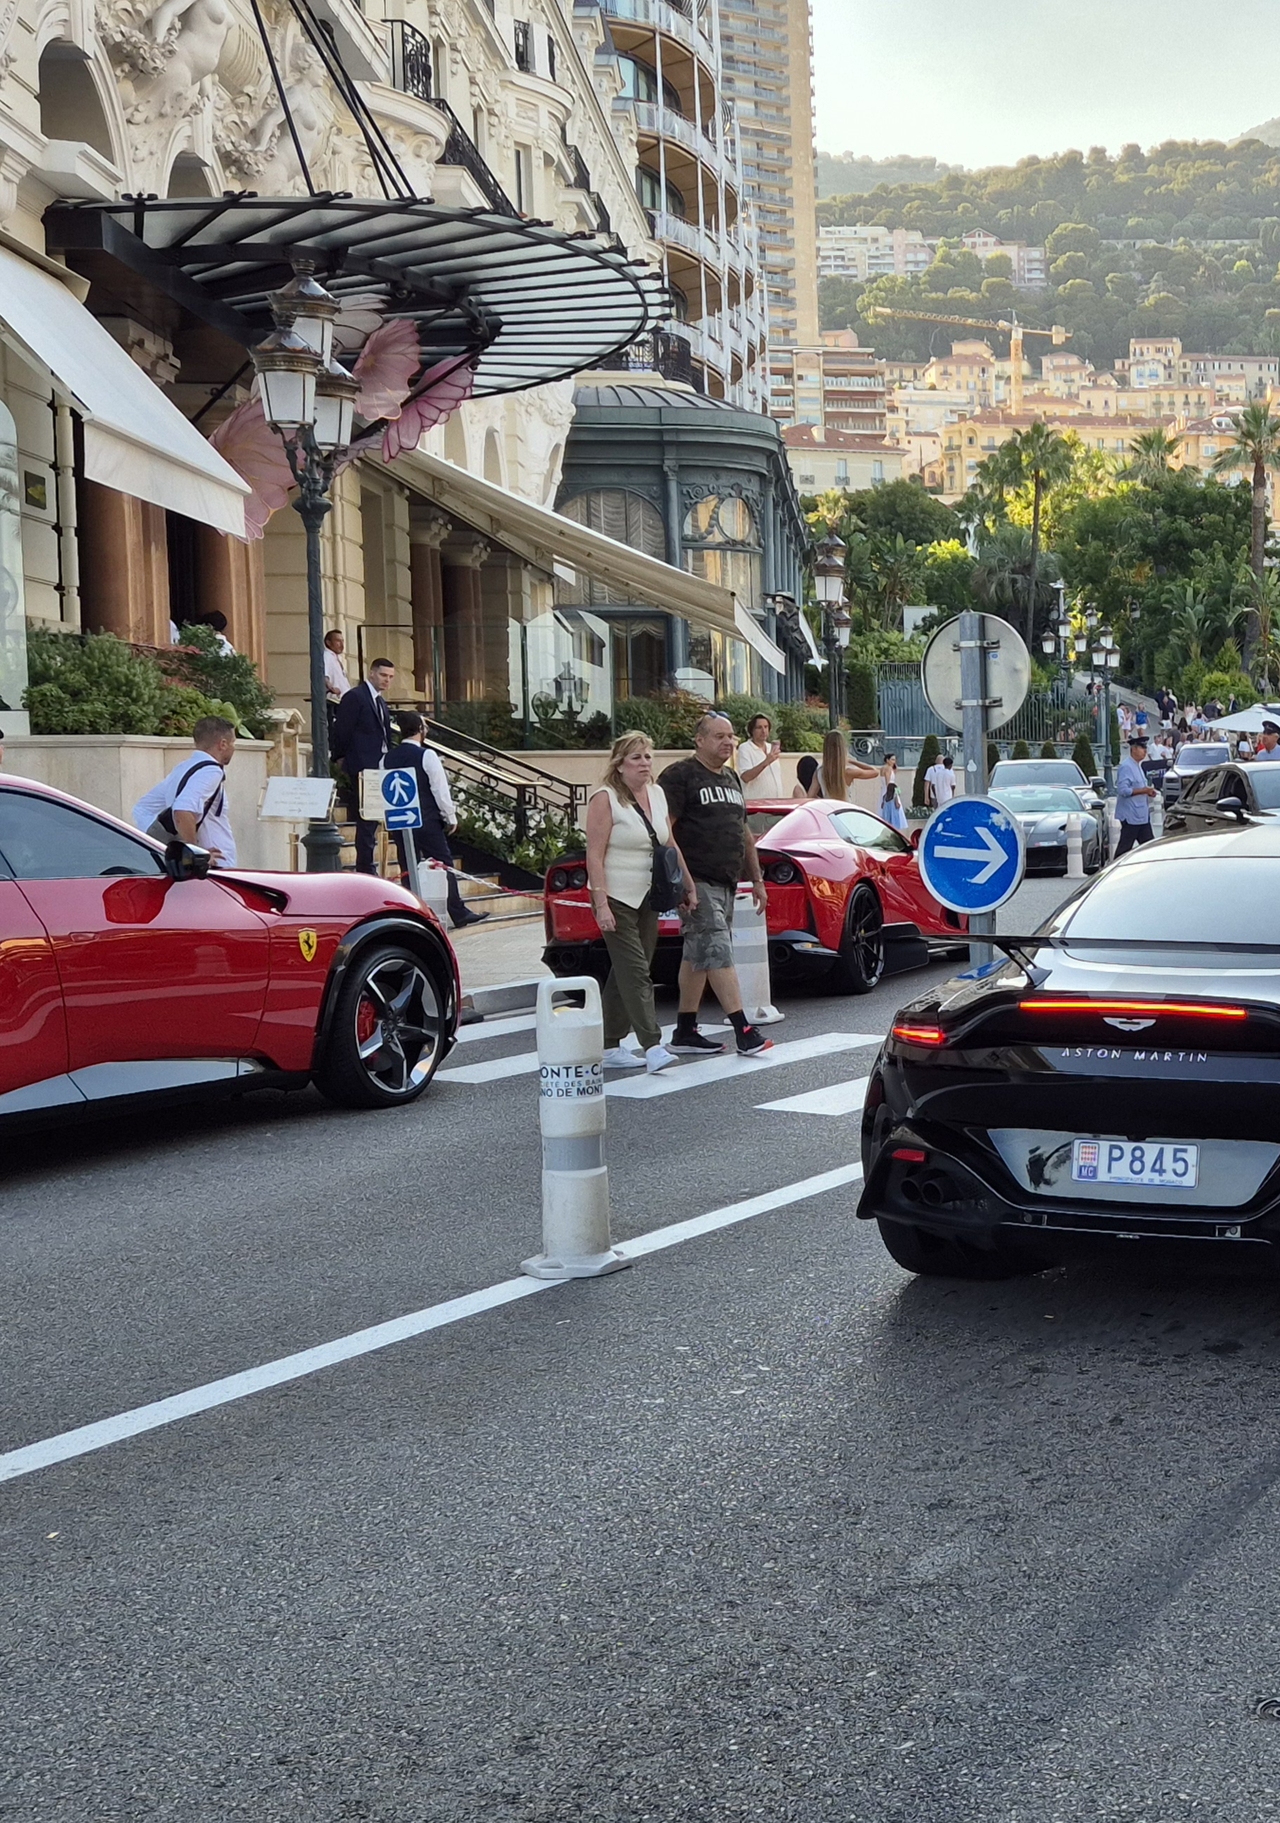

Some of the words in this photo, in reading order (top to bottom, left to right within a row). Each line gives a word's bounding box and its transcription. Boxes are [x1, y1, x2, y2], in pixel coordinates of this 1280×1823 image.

[699, 786, 726, 805] OLD
[1061, 1047, 1122, 1060] ASTON
[1133, 1050, 1207, 1063] MARTIN
[556, 1088, 573, 1097] DE
[1107, 1144, 1189, 1178] P845
[1080, 1165, 1094, 1177] MC
